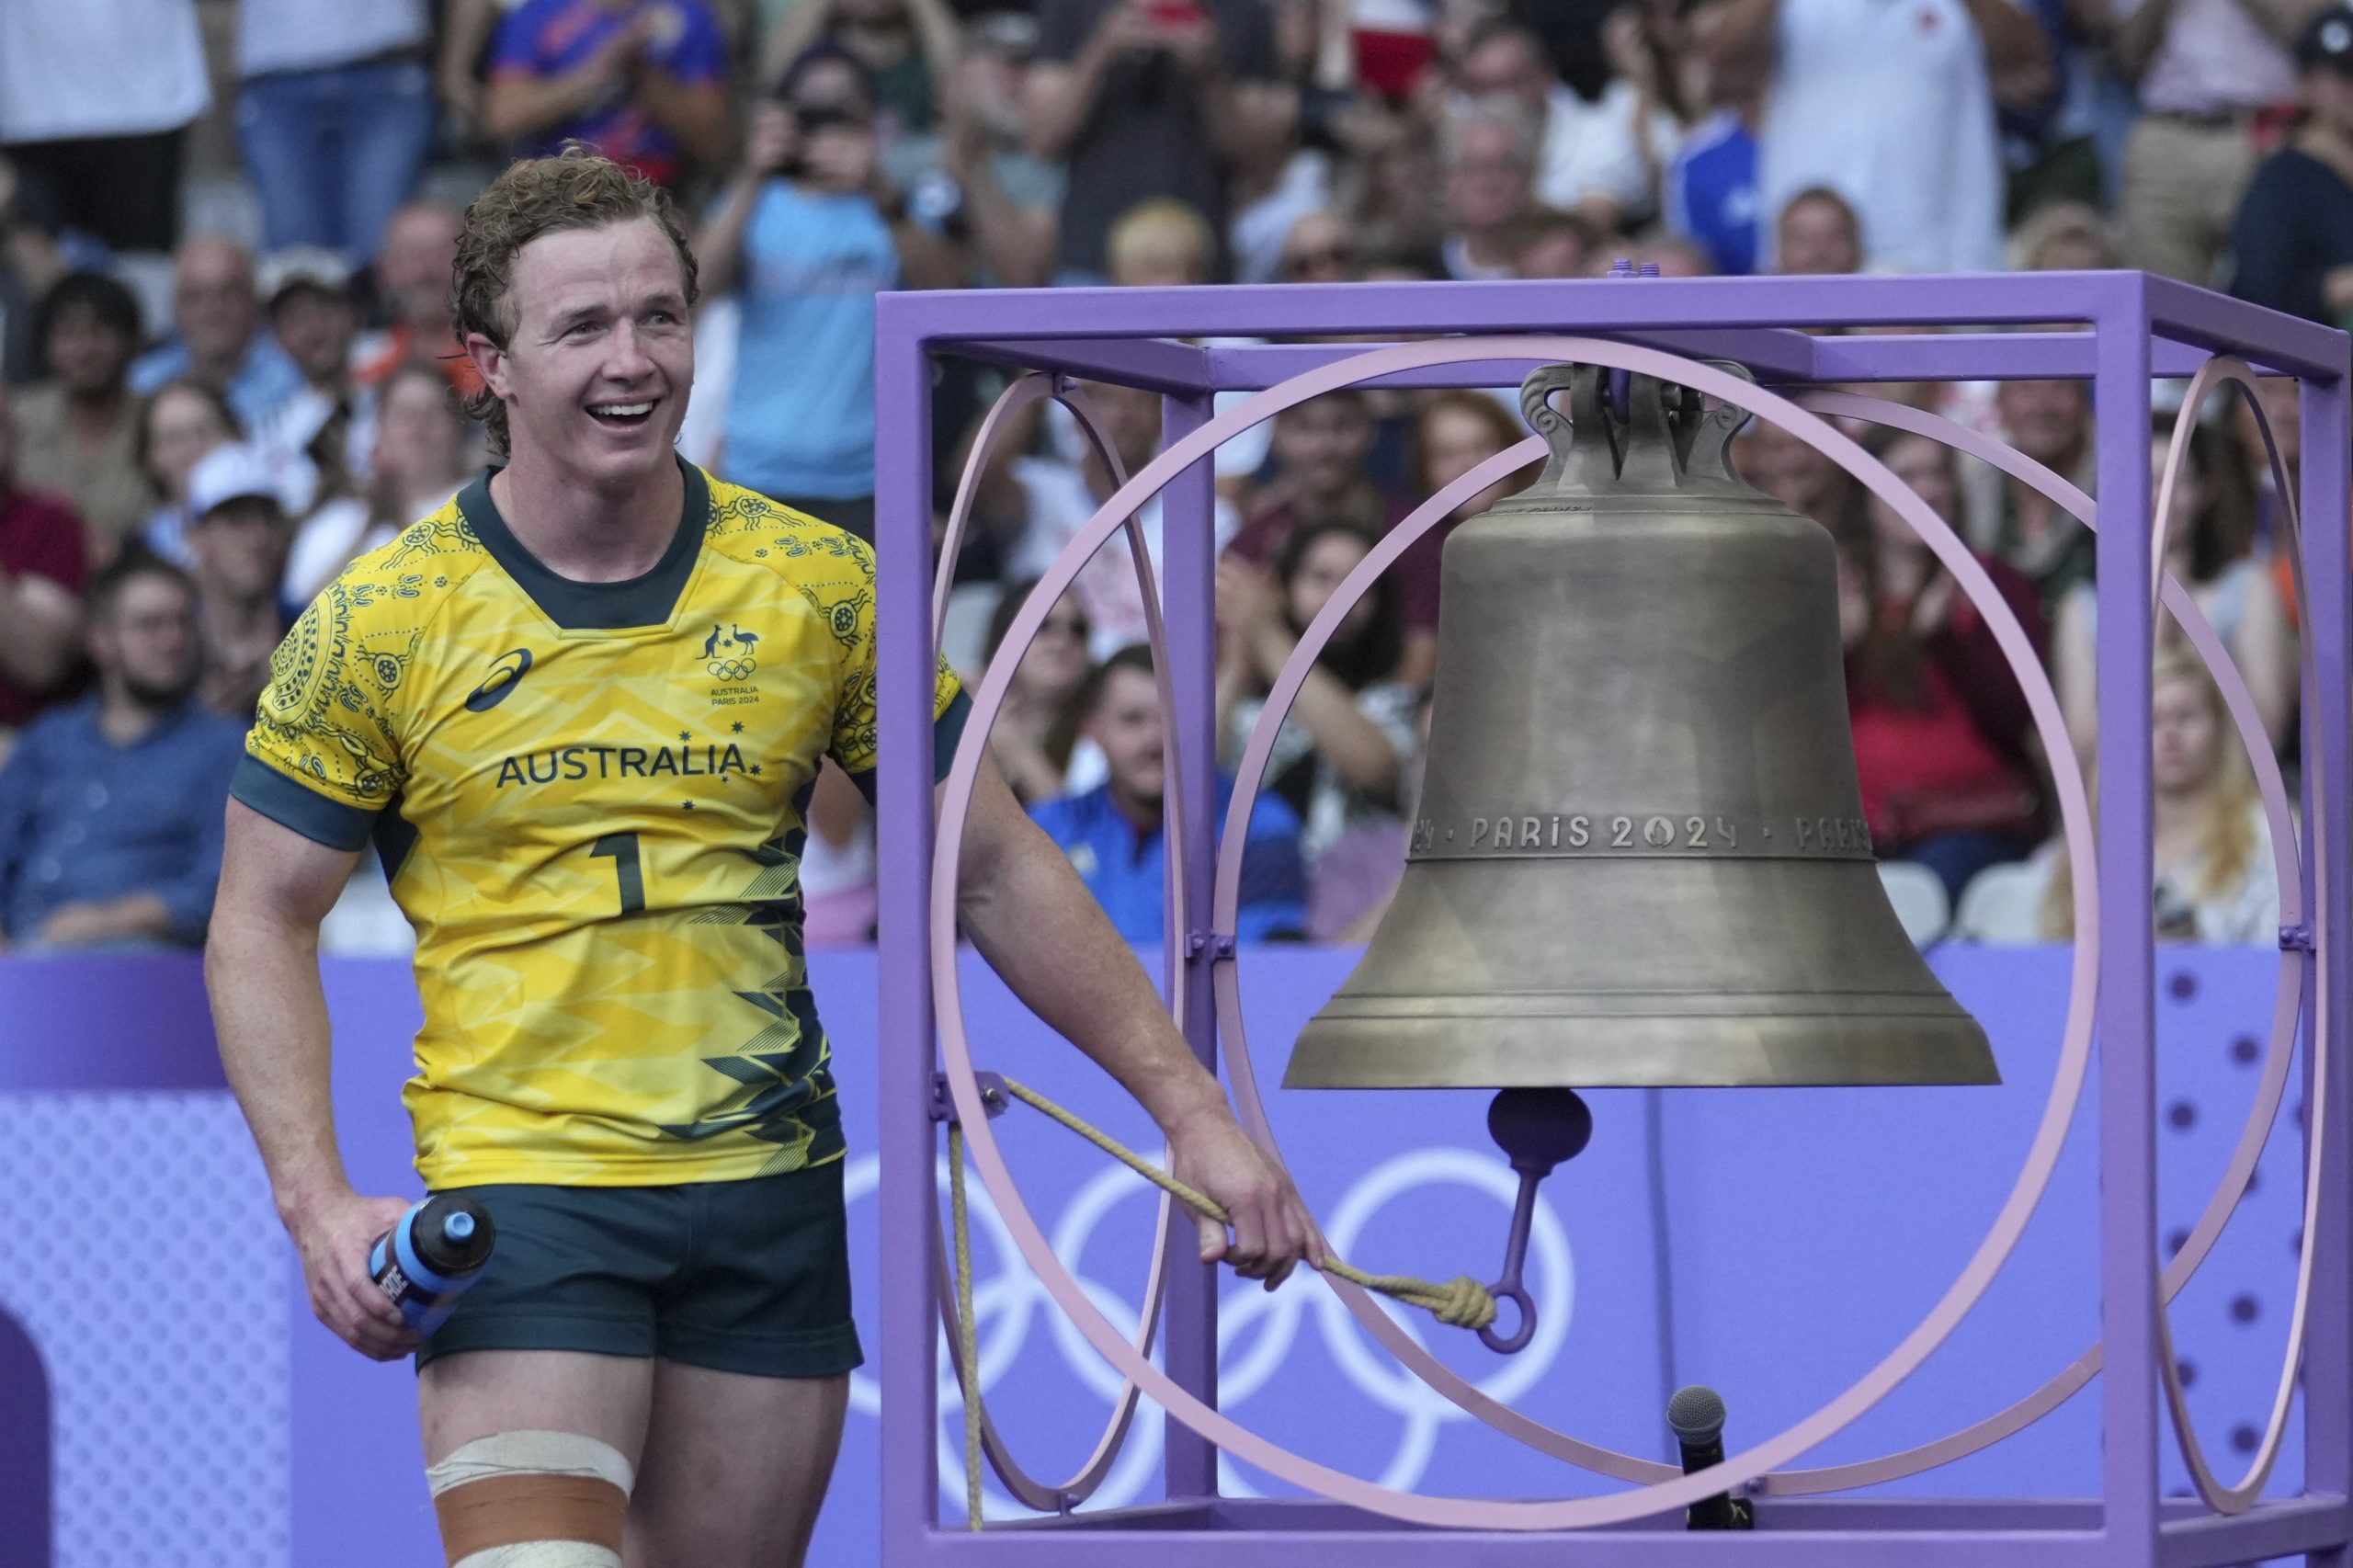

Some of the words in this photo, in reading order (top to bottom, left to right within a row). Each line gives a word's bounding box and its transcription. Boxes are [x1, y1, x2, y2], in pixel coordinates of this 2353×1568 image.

[710, 686, 759, 697] AUSTRALIA
[711, 698, 736, 706] PARIS
[738, 696, 760, 705] 2024
[496, 743, 747, 789] AUSTRALIA
[1610, 816, 1737, 848] 2024
[589, 831, 646, 915] 1
